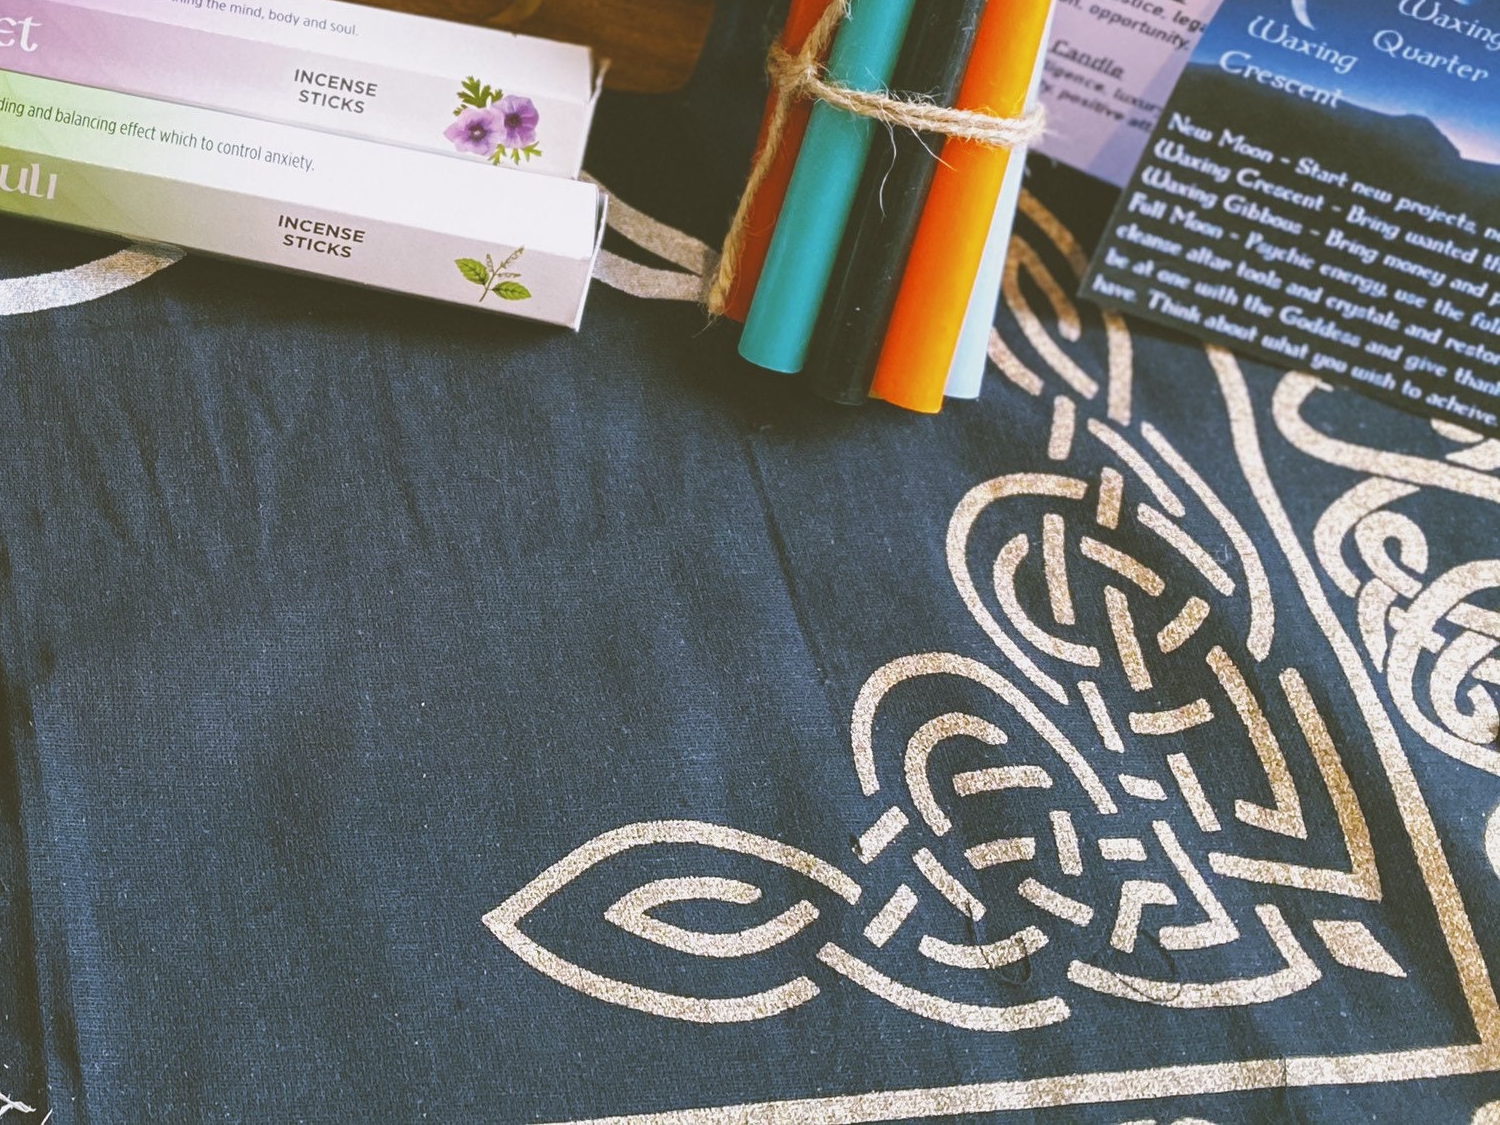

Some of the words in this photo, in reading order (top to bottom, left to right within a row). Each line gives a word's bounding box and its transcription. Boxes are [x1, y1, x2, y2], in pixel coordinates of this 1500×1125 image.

[230, 4, 264, 19] mind,
[269, 9, 300, 26] body
[303, 18, 326, 29] and
[331, 23, 359, 35] soul.
[1248, 15, 1358, 74] Waxing
[1373, 30, 1489, 81] Quarter
[294, 68, 378, 98] INCENSE
[1219, 50, 1343, 109] Crescent
[298, 89, 365, 114] STICKS
[27, 106, 53, 120] and
[55, 107, 117, 135] balancing
[120, 122, 156, 140] effect
[160, 130, 197, 148] which
[217, 142, 261, 160] control
[265, 151, 314, 172] anxiety.
[278, 214, 366, 243] INCENSE
[282, 233, 353, 258] STICKS
